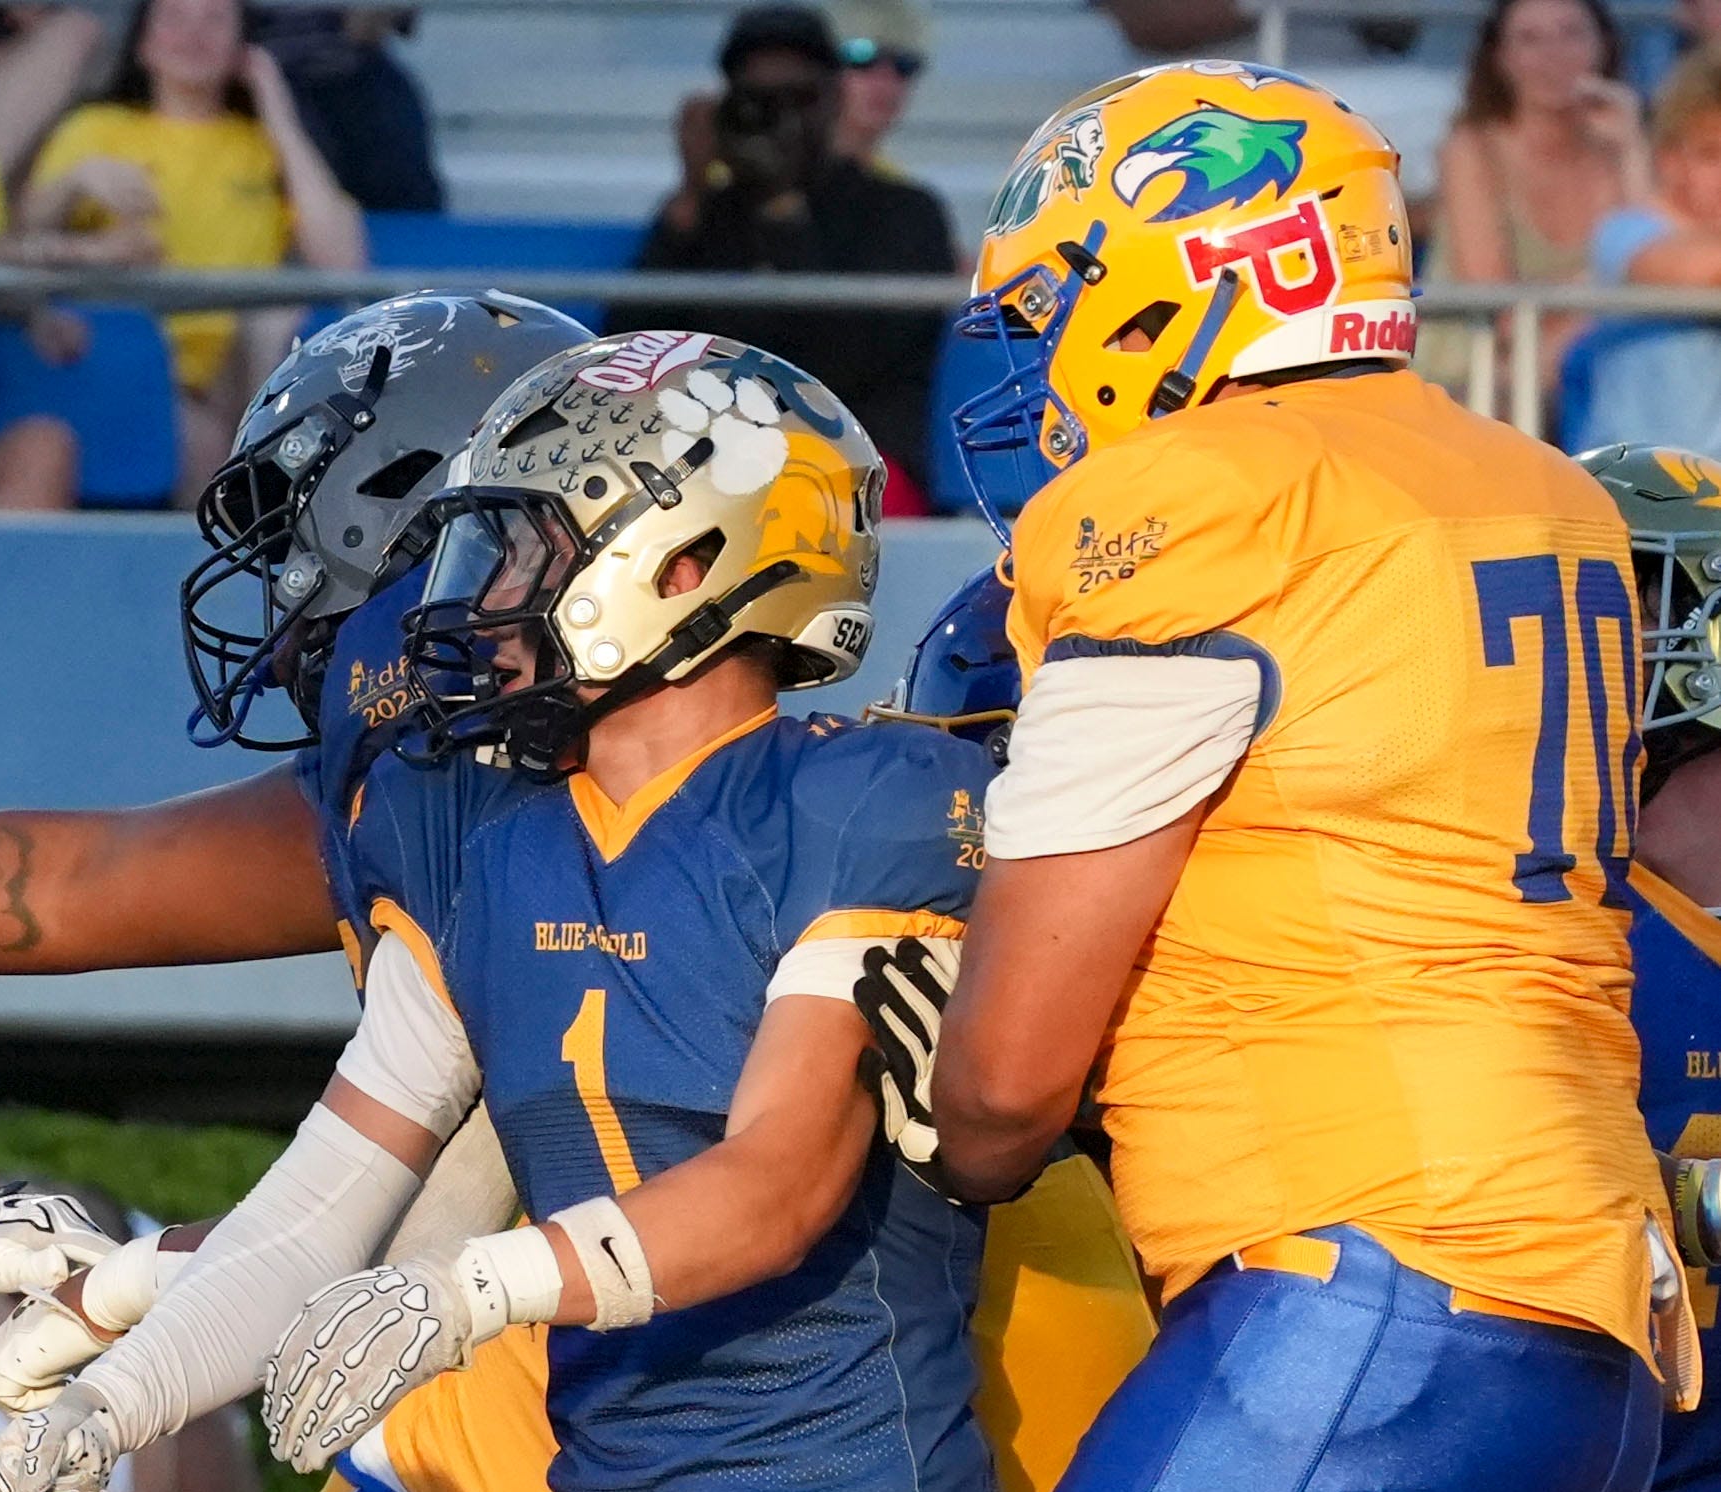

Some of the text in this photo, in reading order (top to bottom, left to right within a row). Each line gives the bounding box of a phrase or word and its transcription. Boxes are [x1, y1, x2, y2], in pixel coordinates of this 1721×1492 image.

[1180, 195, 1339, 319] P
[1330, 311, 1417, 357] Ridd
[363, 690, 425, 728] 202
[1470, 554, 1640, 910] 70
[956, 843, 987, 870] 20
[535, 922, 646, 961] BLUE GOLD
[561, 989, 642, 1196] 1
